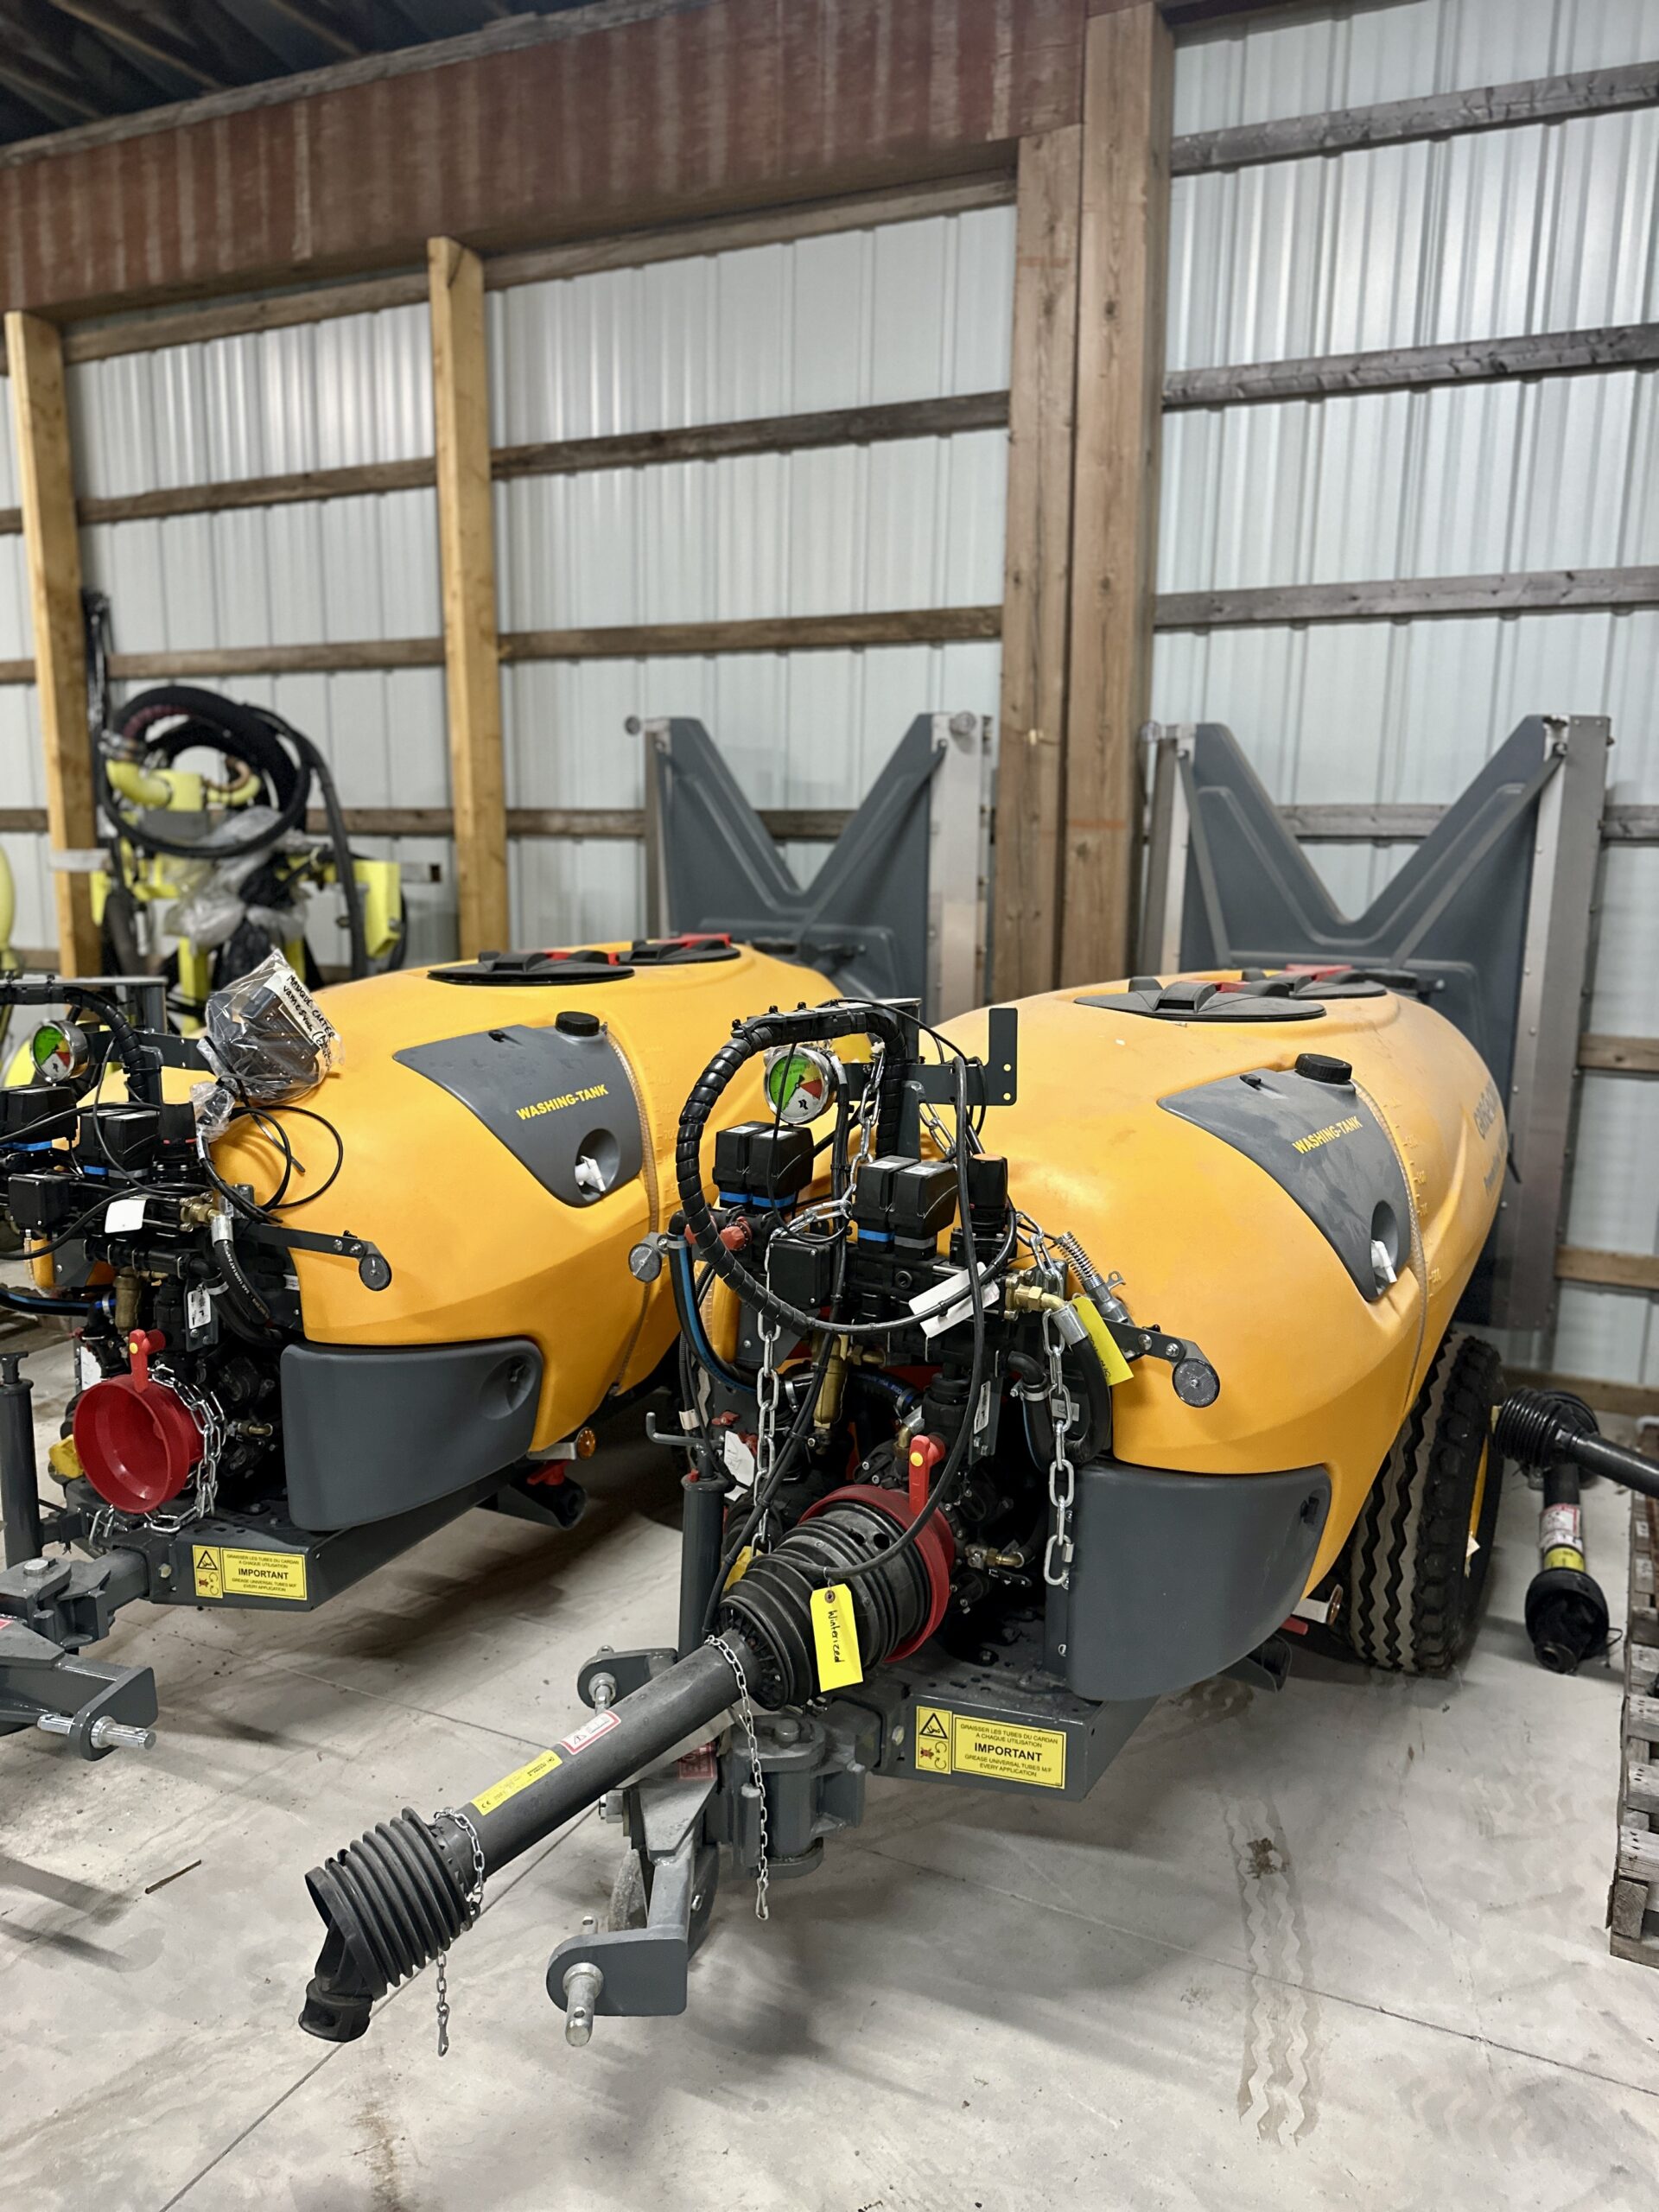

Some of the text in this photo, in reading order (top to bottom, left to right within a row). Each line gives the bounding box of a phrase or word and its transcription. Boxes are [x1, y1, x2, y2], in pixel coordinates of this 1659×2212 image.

[313, 1009, 335, 1037] CARTER
[516, 1084, 609, 1121] WASHING-TANK
[1291, 1115, 1363, 1154] WASHING-TANK
[238, 1567, 289, 1580] IMPORTANT
[828, 1610, 845, 1663] Winterized
[961, 1724, 989, 1733] GRAISSER
[990, 1726, 1002, 1735] LES
[1003, 1730, 1022, 1738] TUBES
[1033, 1734, 1058, 1745] CARDAN
[982, 1733, 1006, 1743] CHAQUE
[1007, 1737, 1042, 1748] UTILISATION
[975, 1742, 1042, 1762] IMPORTANT
[964, 1754, 988, 1763] GREASE
[988, 1758, 1021, 1768] UNIVERSAL
[1021, 1763, 1040, 1772] TUBES
[980, 1763, 1037, 1777] EVERY APPLICATION
